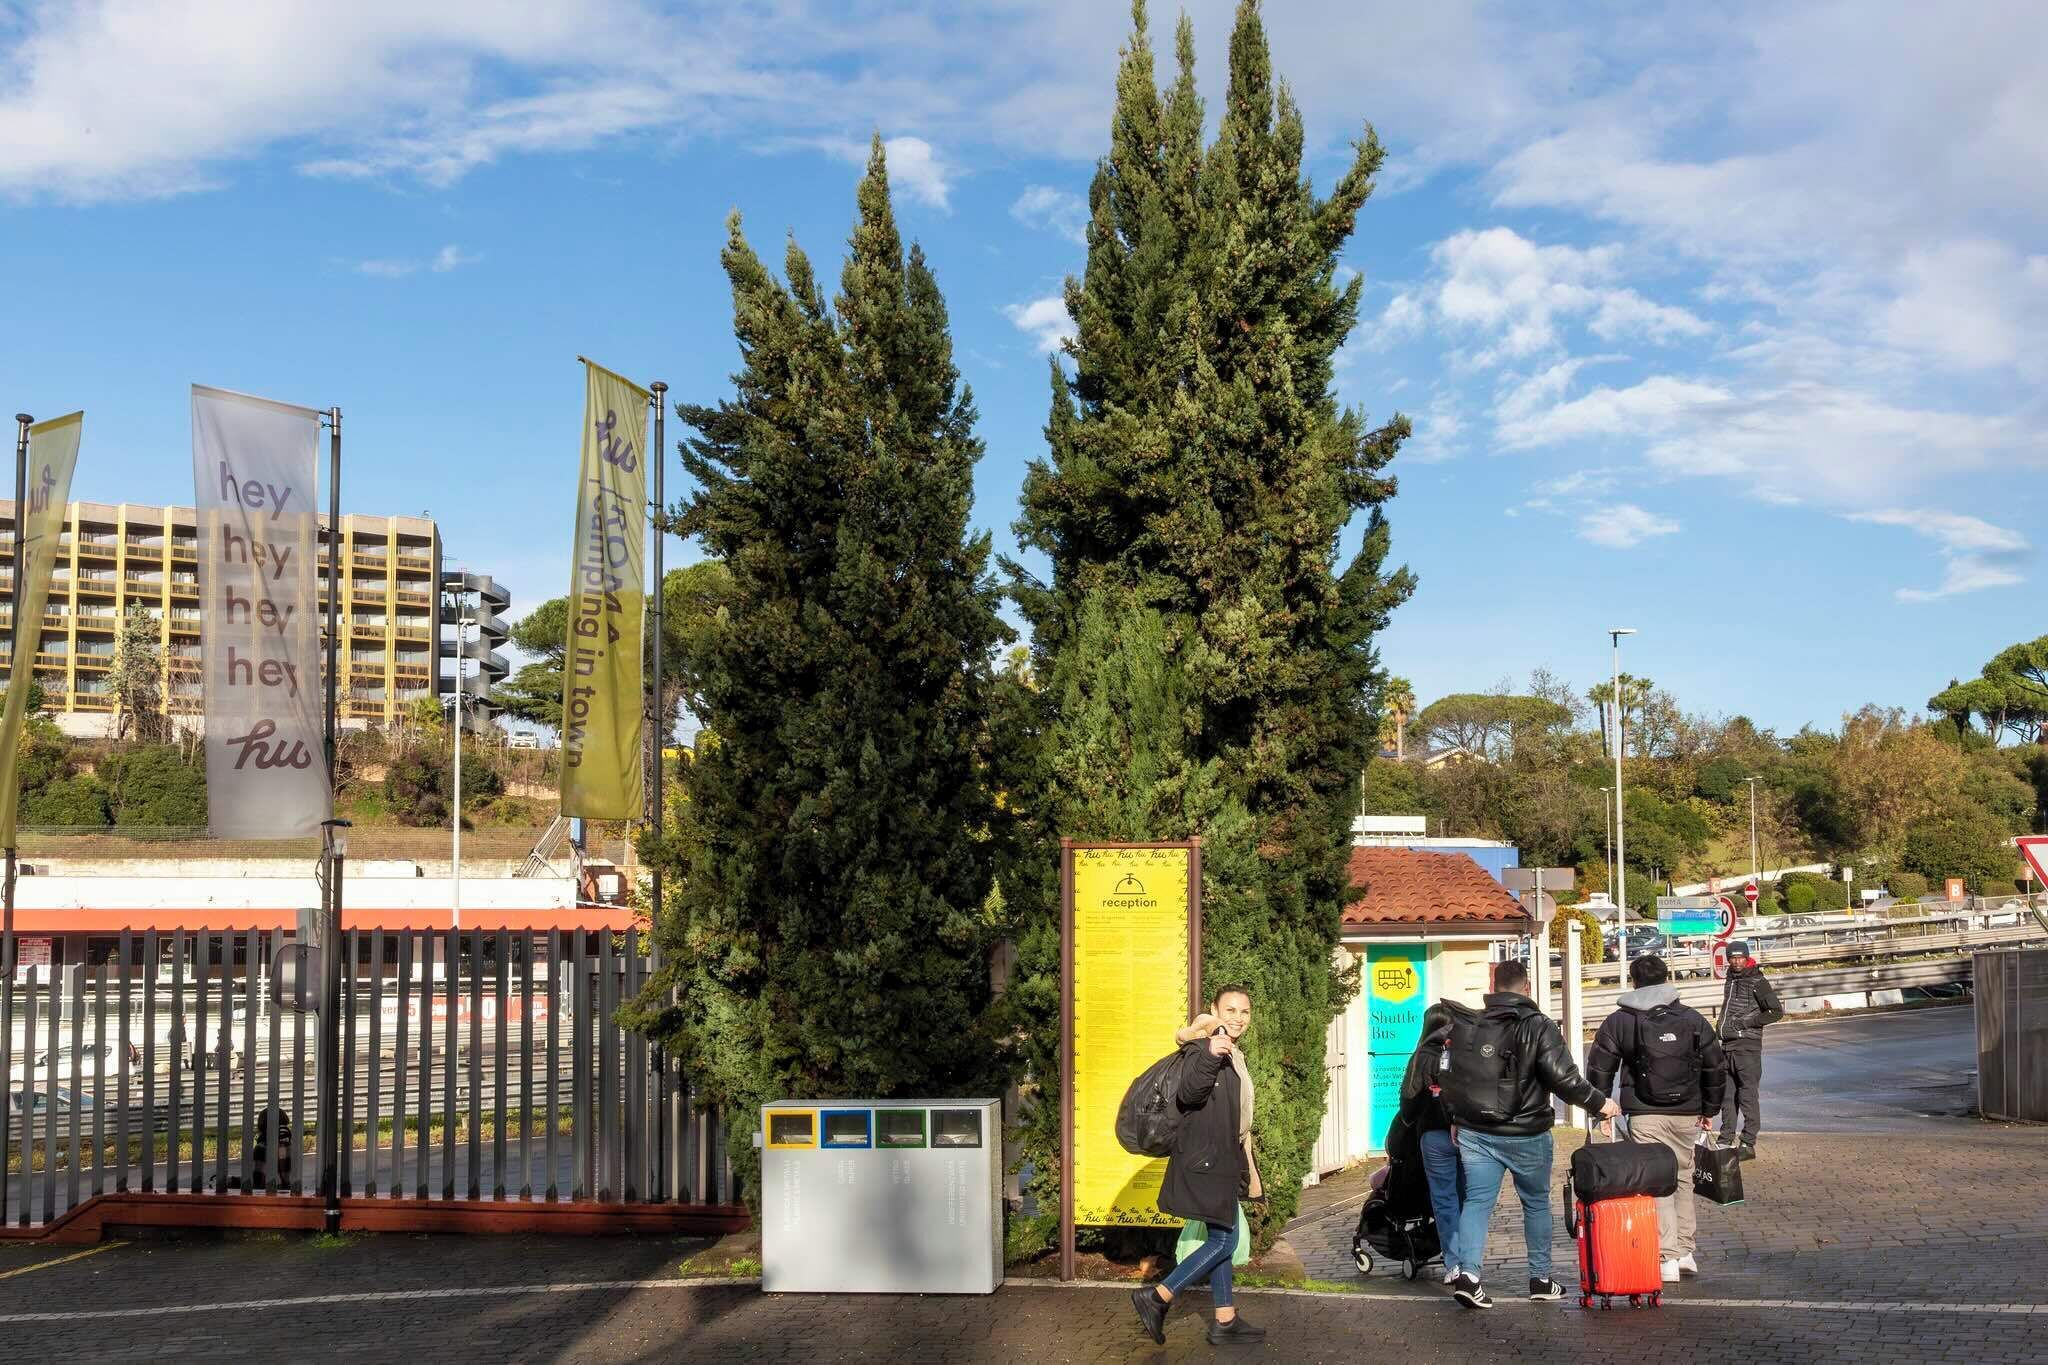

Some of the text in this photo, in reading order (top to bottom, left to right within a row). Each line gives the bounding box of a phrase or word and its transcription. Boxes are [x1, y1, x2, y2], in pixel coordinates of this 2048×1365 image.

[220, 461, 292, 520] hey
[224, 523, 292, 580] hey
[226, 585, 294, 635] hey
[568, 494, 605, 768] camping in town
[228, 646, 298, 698] hey
[226, 718, 312, 770] hu
[1102, 898, 1157, 909] reception
[1721, 910, 1729, 927] 0
[1371, 1008, 1418, 1024] Shuttle
[1372, 1026, 1396, 1040] Bus
